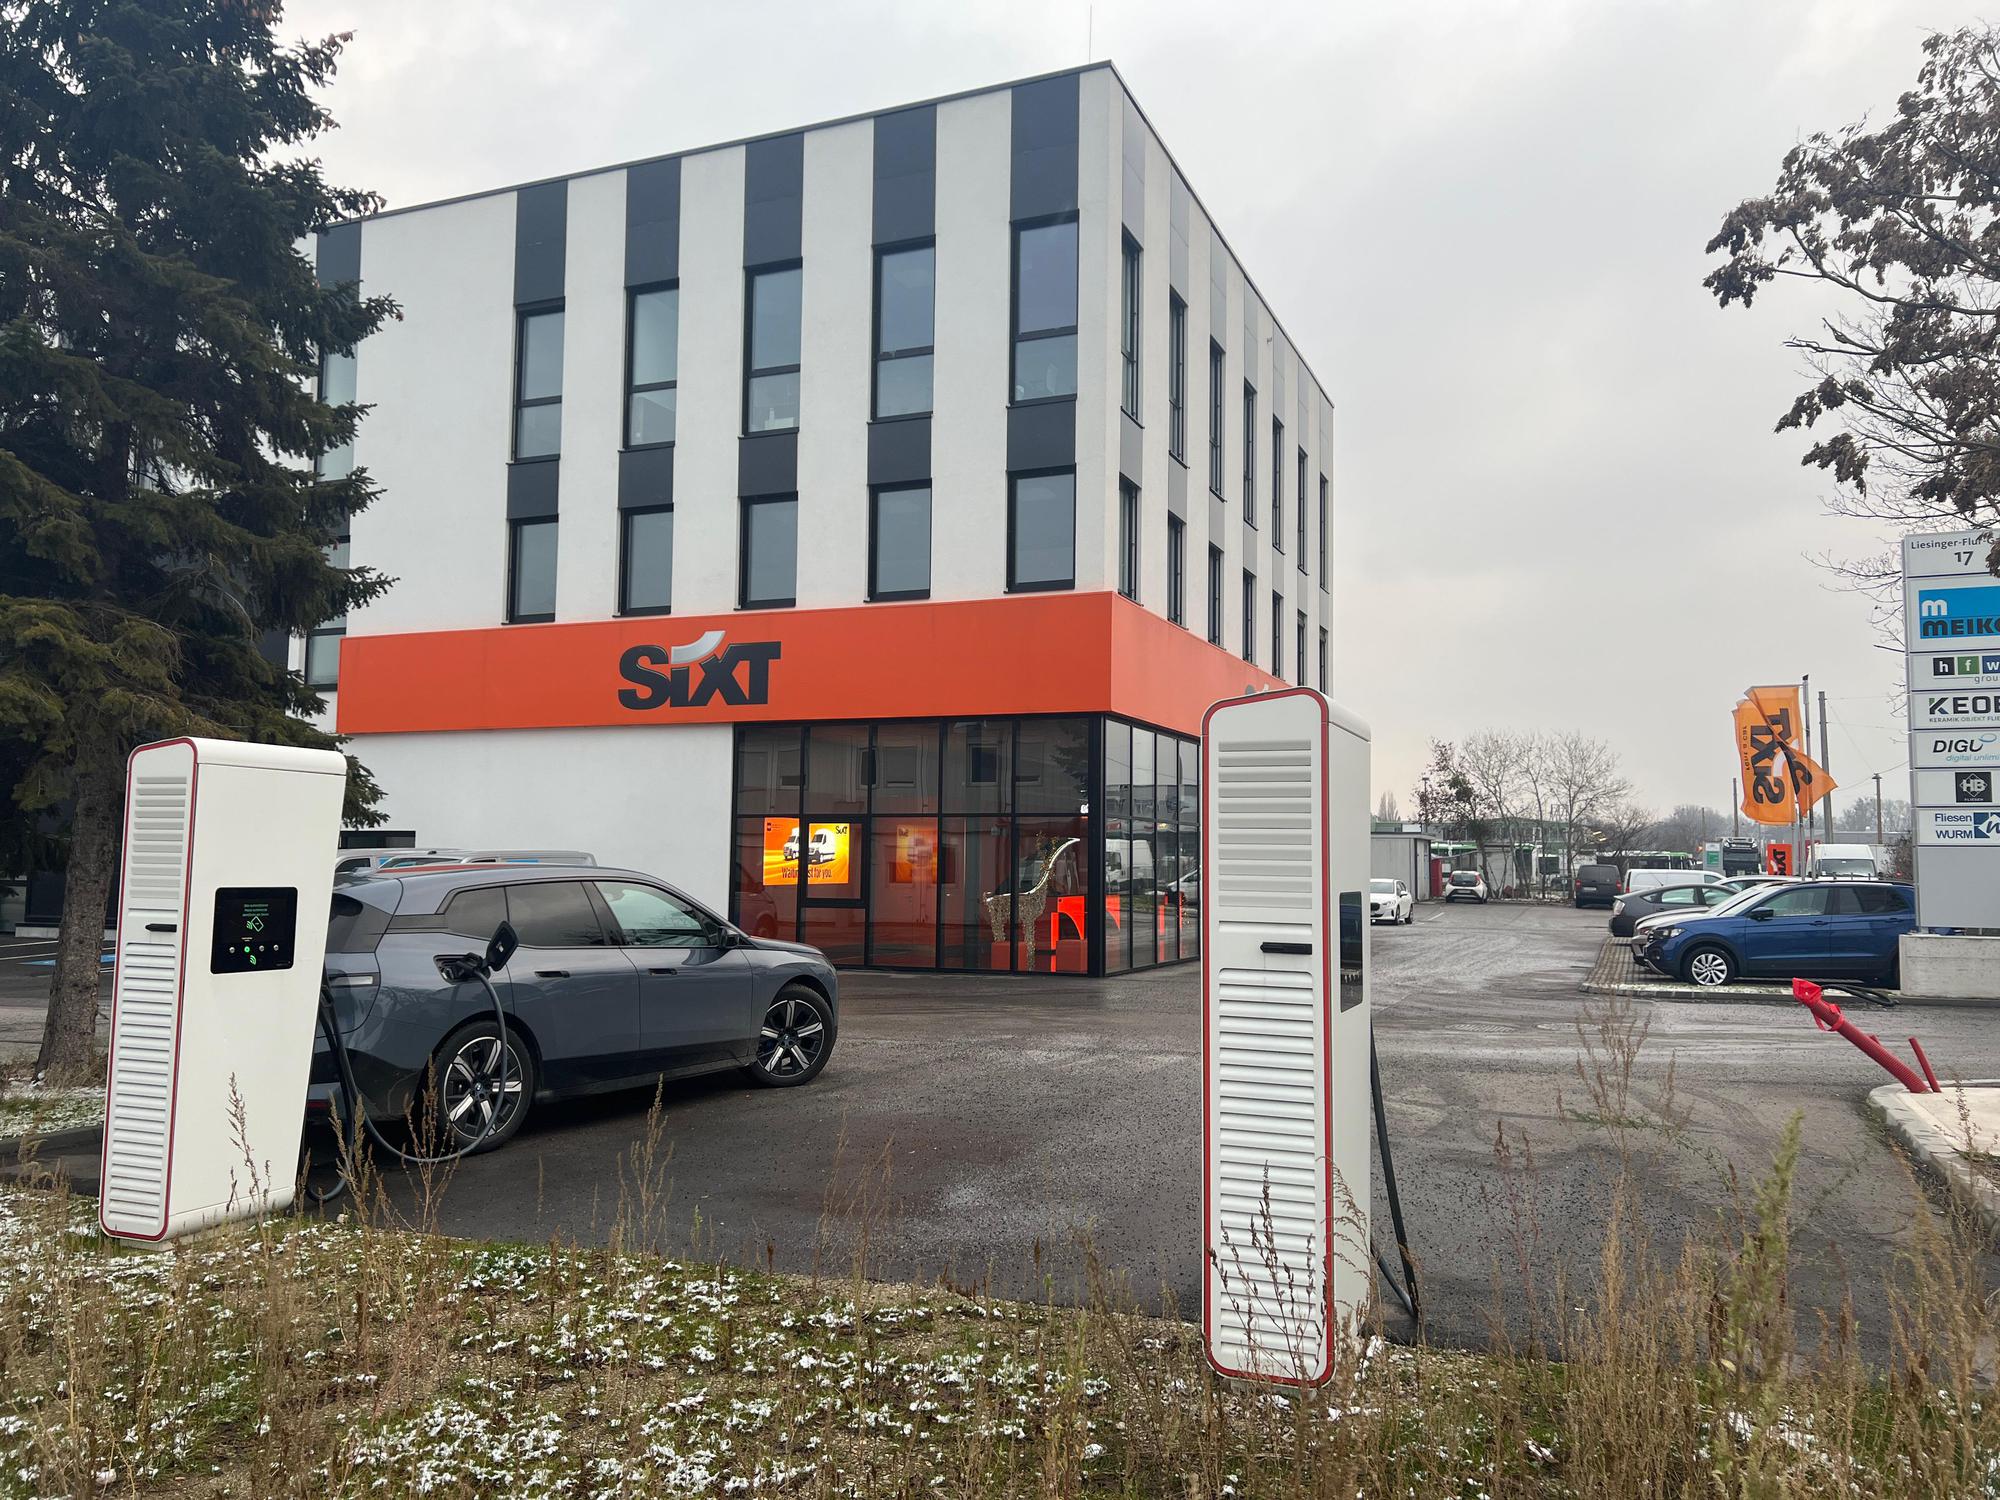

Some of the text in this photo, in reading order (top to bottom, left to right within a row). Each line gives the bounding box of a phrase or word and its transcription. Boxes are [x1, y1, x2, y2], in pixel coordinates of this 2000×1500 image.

[1911, 537, 1996, 550] Liesinger-Flur-G
[1954, 551, 1974, 566] 17
[1974, 675, 2000, 685] grou
[1946, 754, 2000, 763] digital unlimi
[1935, 813, 1973, 822] Fliesen
[1936, 830, 1973, 838] WURM
